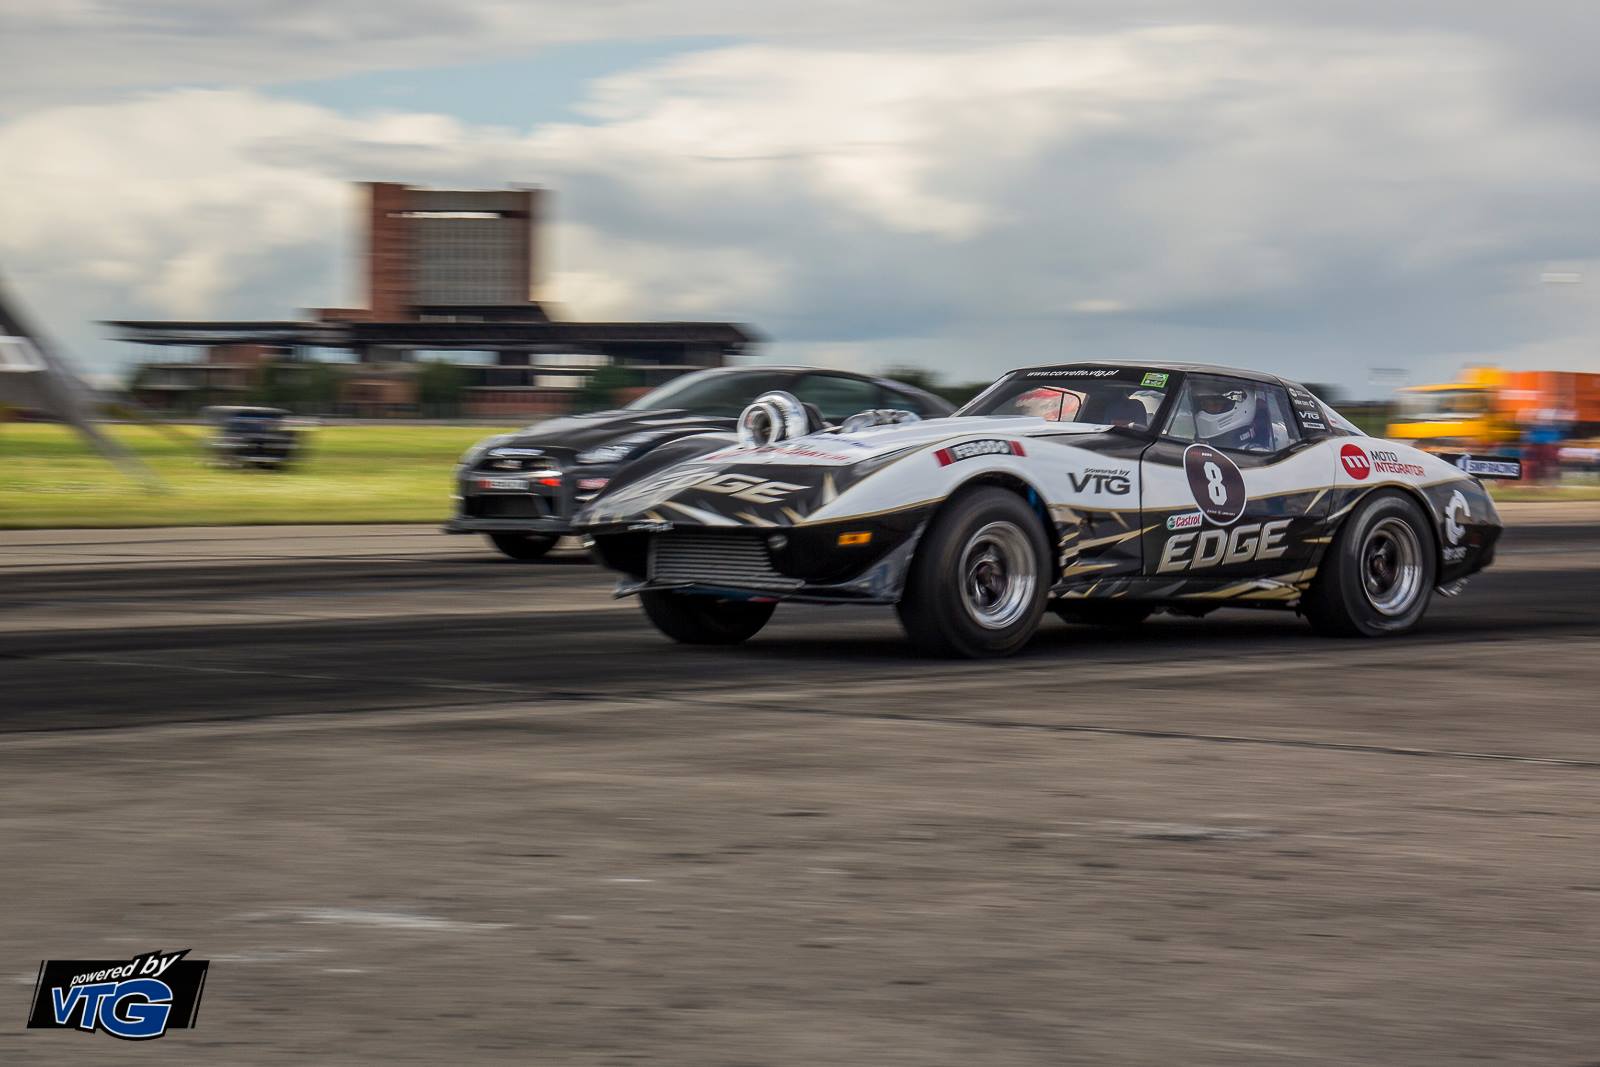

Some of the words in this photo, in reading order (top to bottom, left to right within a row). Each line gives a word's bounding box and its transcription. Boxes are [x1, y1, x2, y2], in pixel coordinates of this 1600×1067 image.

[1299, 411, 1320, 420] VTG
[1370, 450, 1398, 463] MOTO
[1374, 462, 1426, 477] INTEGRATOR
[1067, 472, 1131, 495] VTG
[1203, 461, 1227, 506] 8
[1175, 515, 1201, 528] Castrol
[1156, 518, 1294, 574] EDGE
